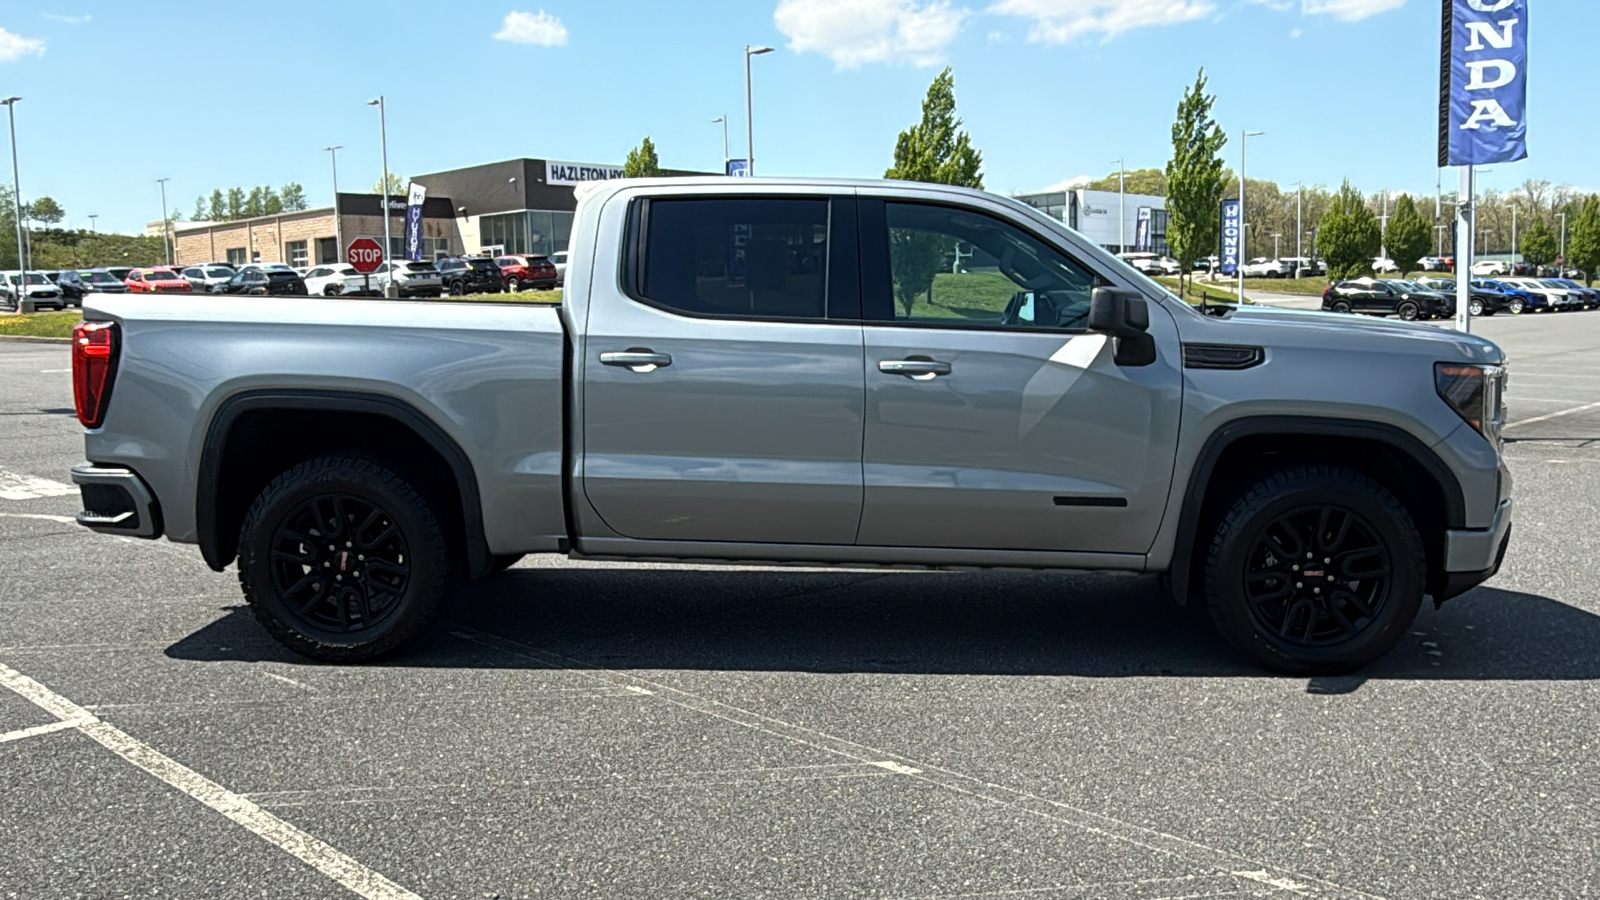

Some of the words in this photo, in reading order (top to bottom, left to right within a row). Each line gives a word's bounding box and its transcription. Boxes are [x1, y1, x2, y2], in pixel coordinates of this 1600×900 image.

[1460, 0, 1518, 130] NDA
[551, 165, 607, 181] HAZLETON
[609, 169, 626, 179] HY
[349, 248, 381, 263] STOP
[1224, 219, 1238, 265] HONDA
